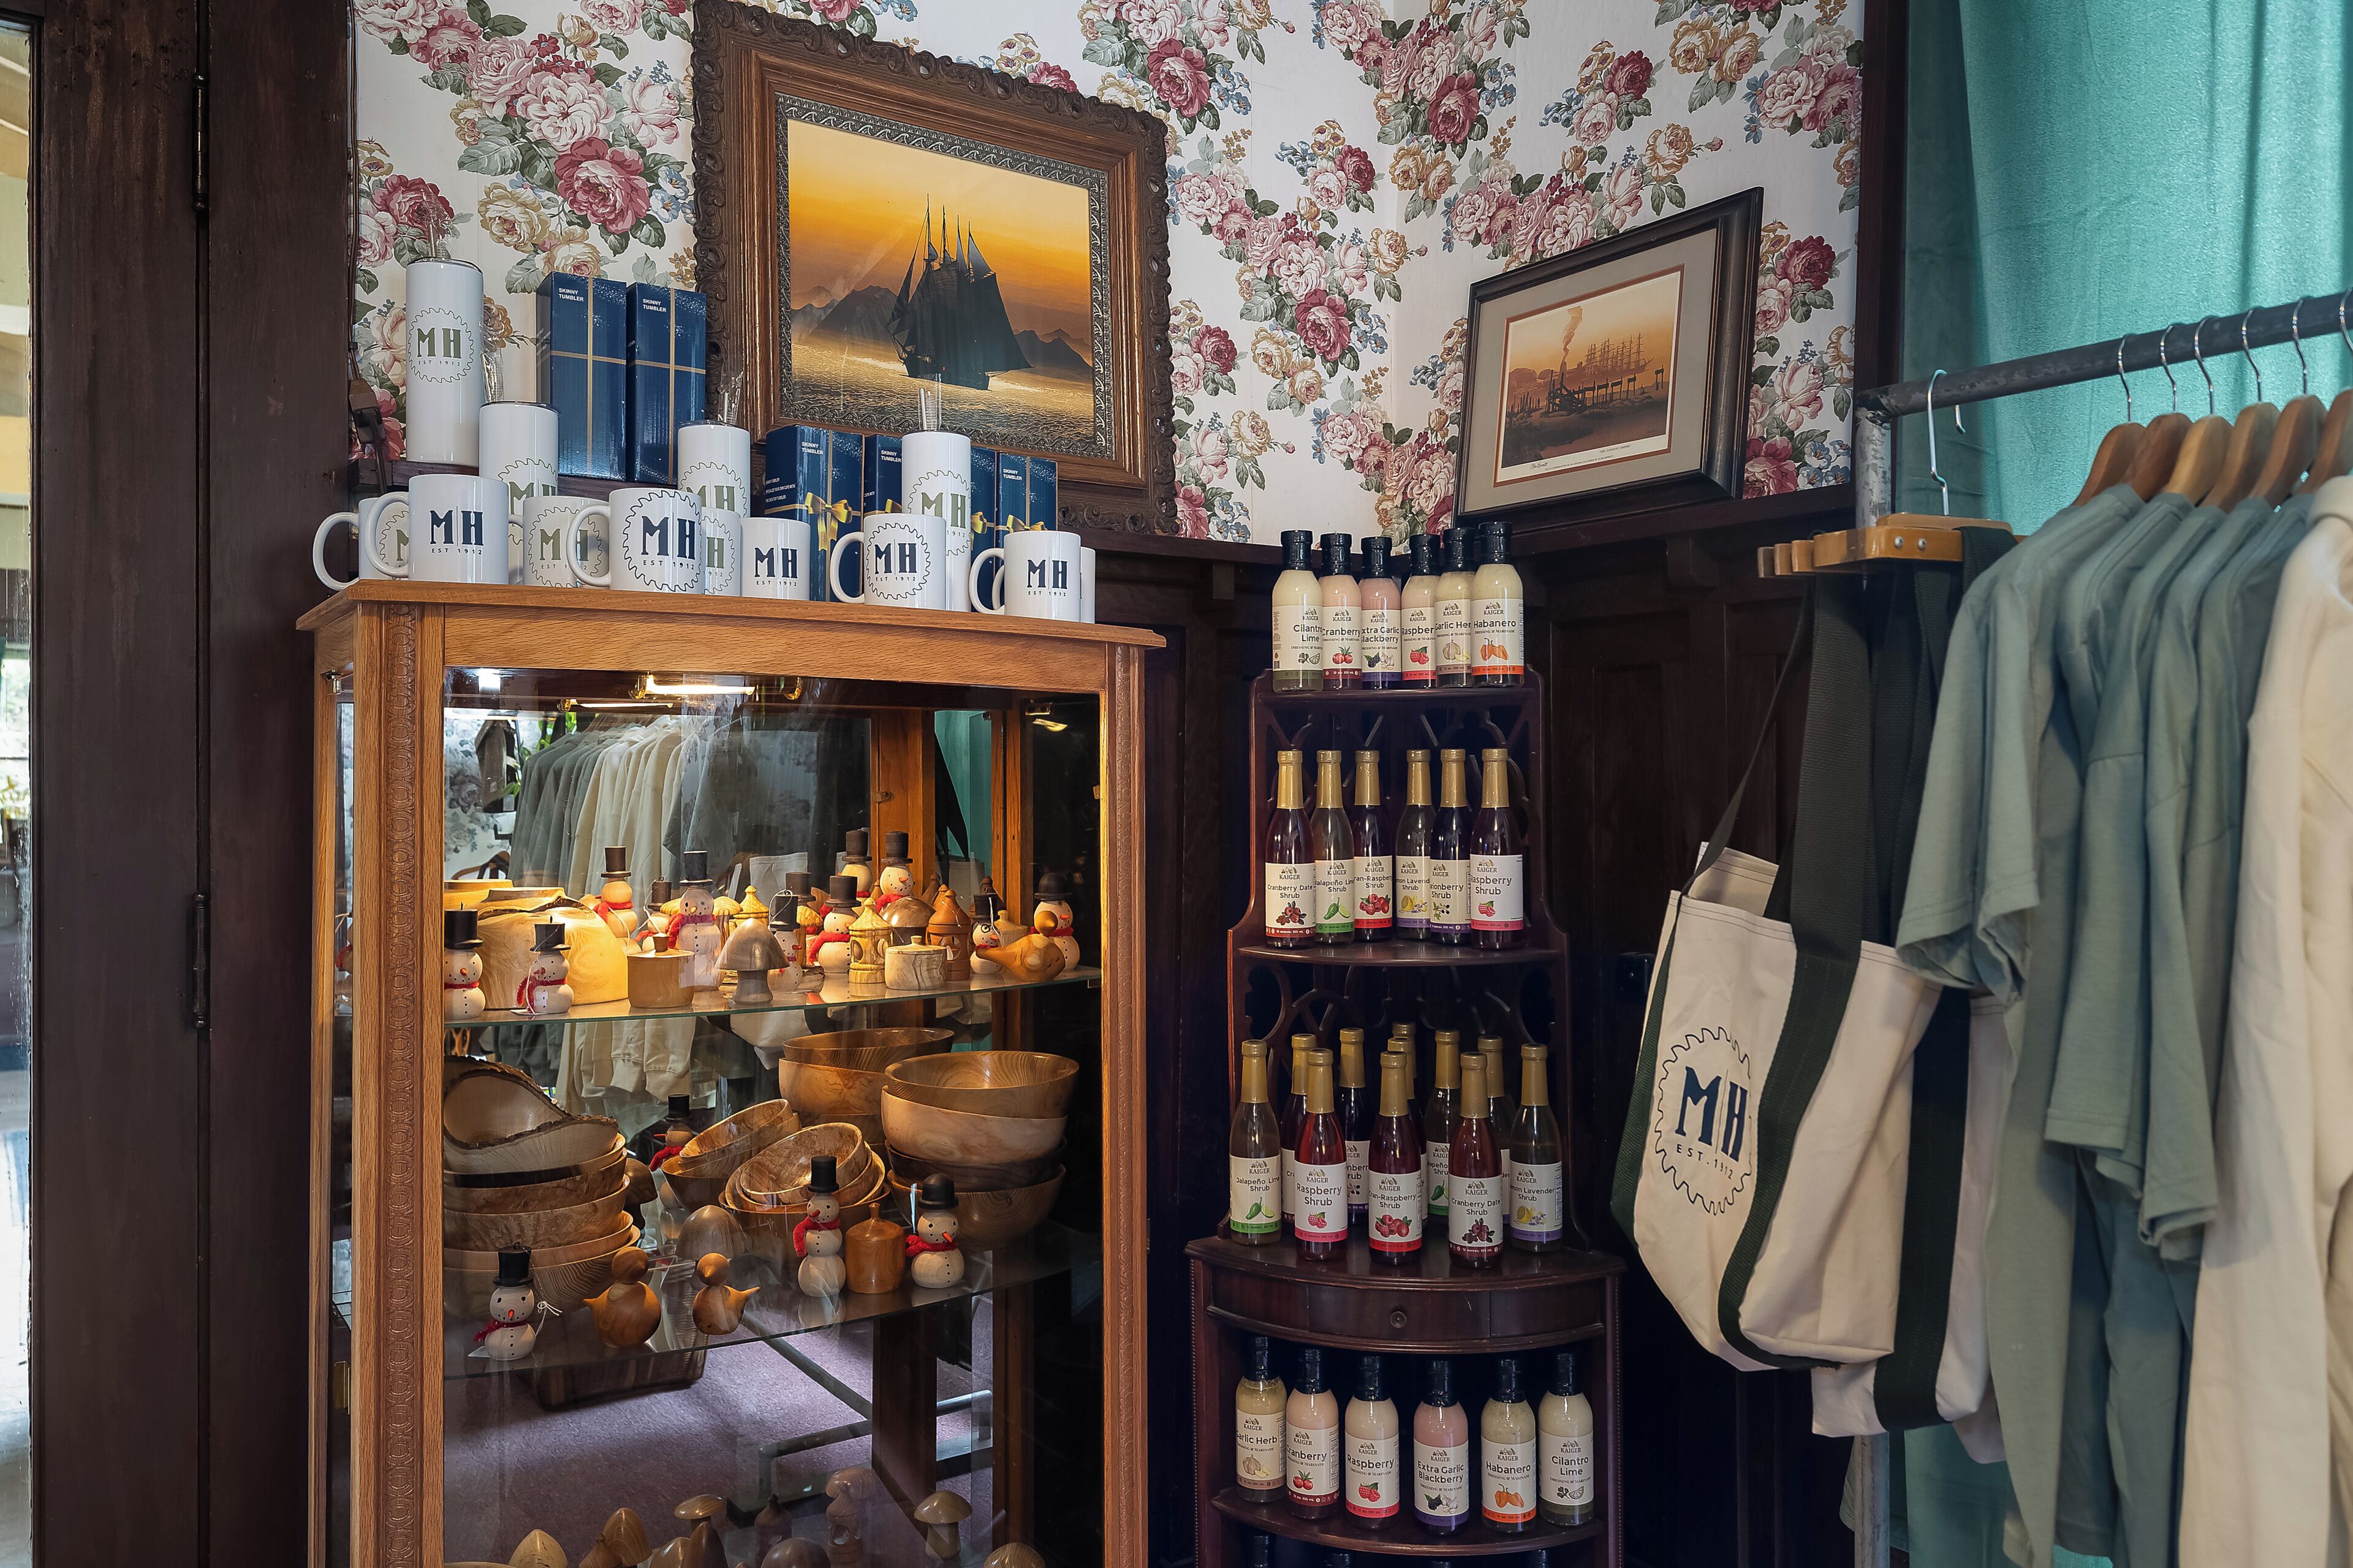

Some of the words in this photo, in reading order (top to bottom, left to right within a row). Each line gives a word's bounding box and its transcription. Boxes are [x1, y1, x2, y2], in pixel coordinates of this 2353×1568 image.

[672, 561, 694, 570] 1912
[1474, 619, 1516, 628] Habanero
[1471, 875, 1512, 886] Raspberry
[1476, 886, 1501, 895] Shrub
[1237, 1177, 1265, 1186] Jalapeño
[1297, 1183, 1342, 1195] Raspberry
[1304, 1196, 1333, 1206] Shrub
[1369, 1191, 1416, 1202] Cran-Raspberry
[1451, 1197, 1485, 1208] Cranberry
[1257, 1436, 1278, 1444] Herb
[1294, 1437, 1313, 1446] KAIGER
[1347, 1453, 1394, 1469] Raspberry
[1552, 1456, 1589, 1466] Cilantro
[1418, 1460, 1439, 1474] Extra
[1441, 1464, 1464, 1474] Garlic
[1486, 1461, 1531, 1474] Habanero
[1560, 1468, 1583, 1476] Lime
[1419, 1471, 1463, 1483] Blackberry
